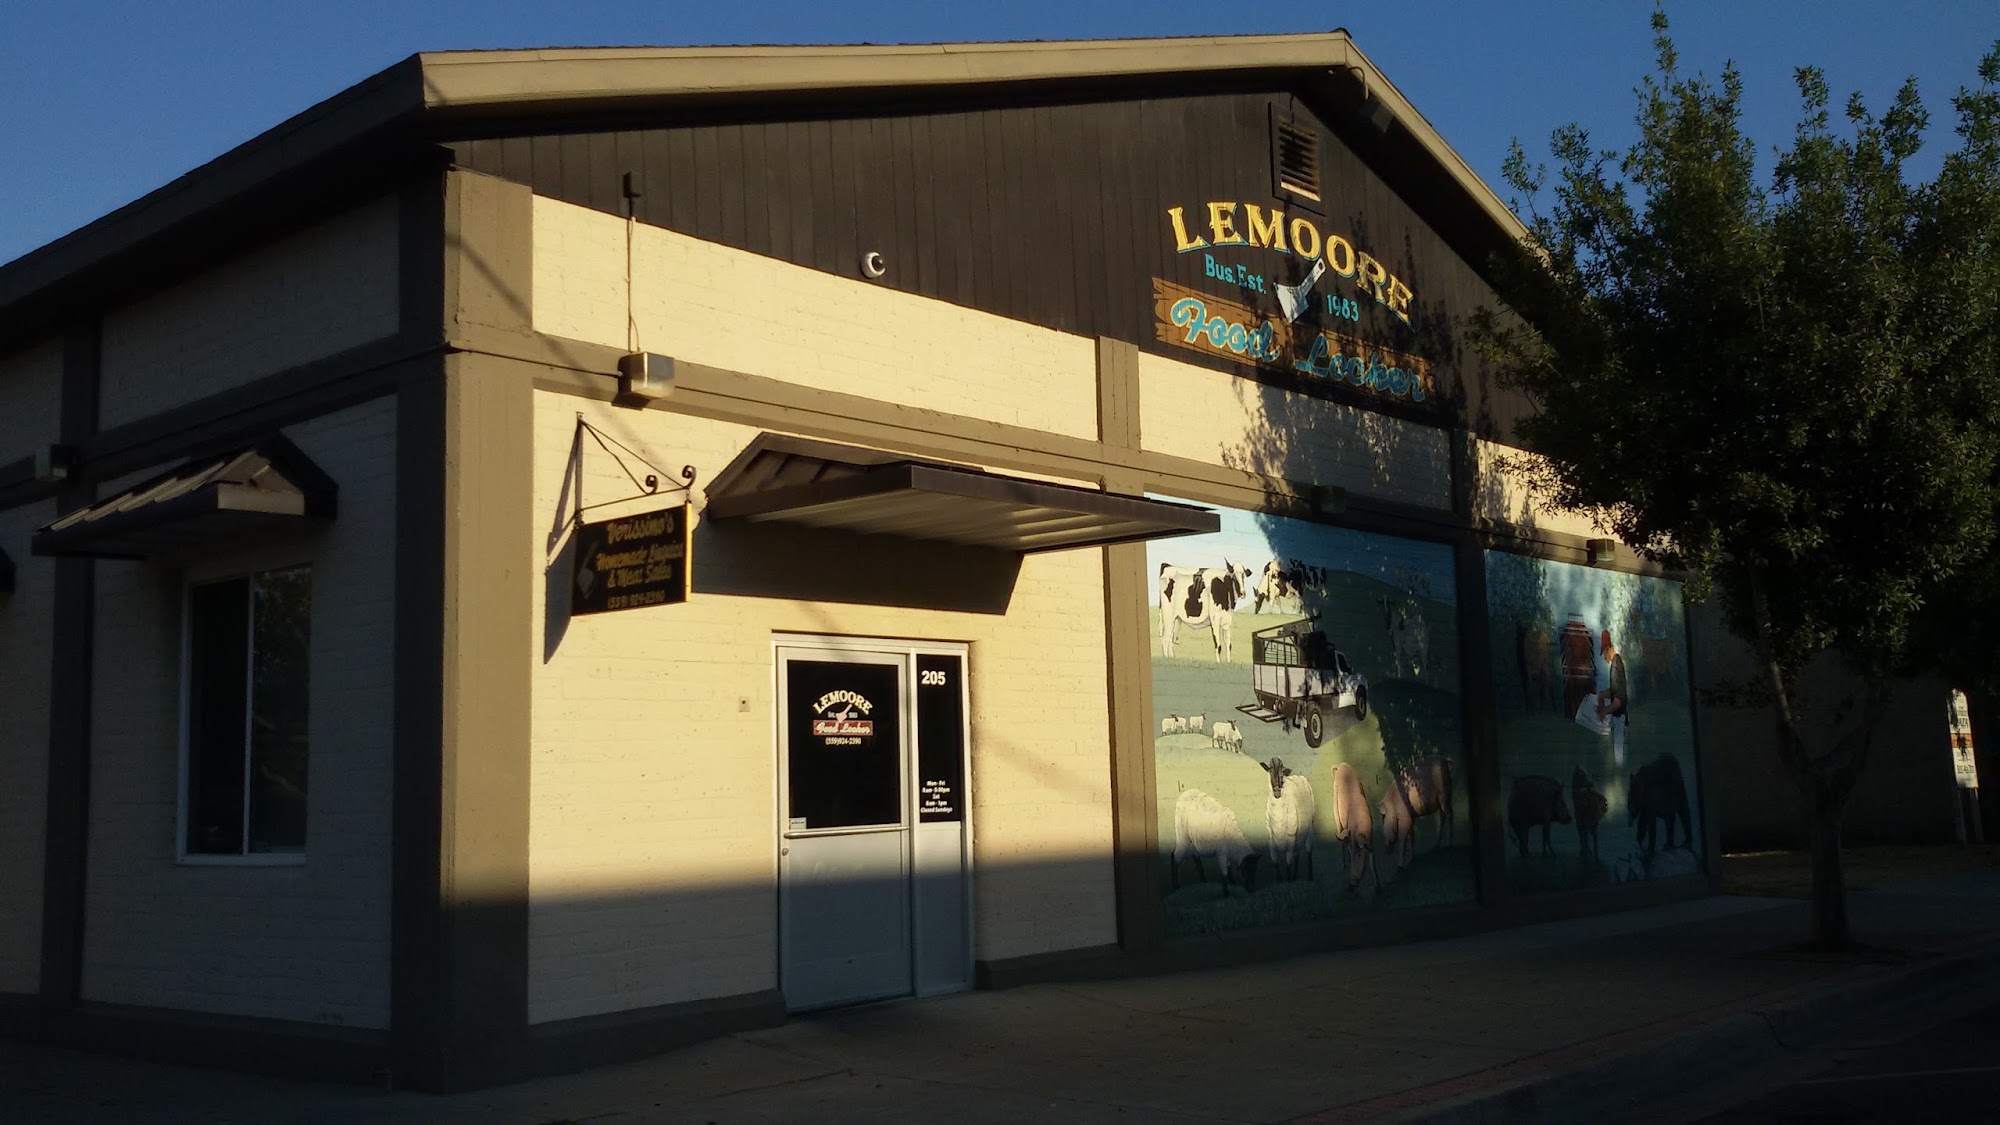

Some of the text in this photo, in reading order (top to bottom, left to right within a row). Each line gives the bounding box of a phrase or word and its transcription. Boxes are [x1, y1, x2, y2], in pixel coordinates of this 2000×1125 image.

[1167, 201, 1416, 333] LEMOORE
[1326, 294, 1360, 322] 1983
[1170, 297, 1426, 403] Food Locker
[921, 670, 946, 685] 205
[813, 690, 873, 715] LEMOORE
